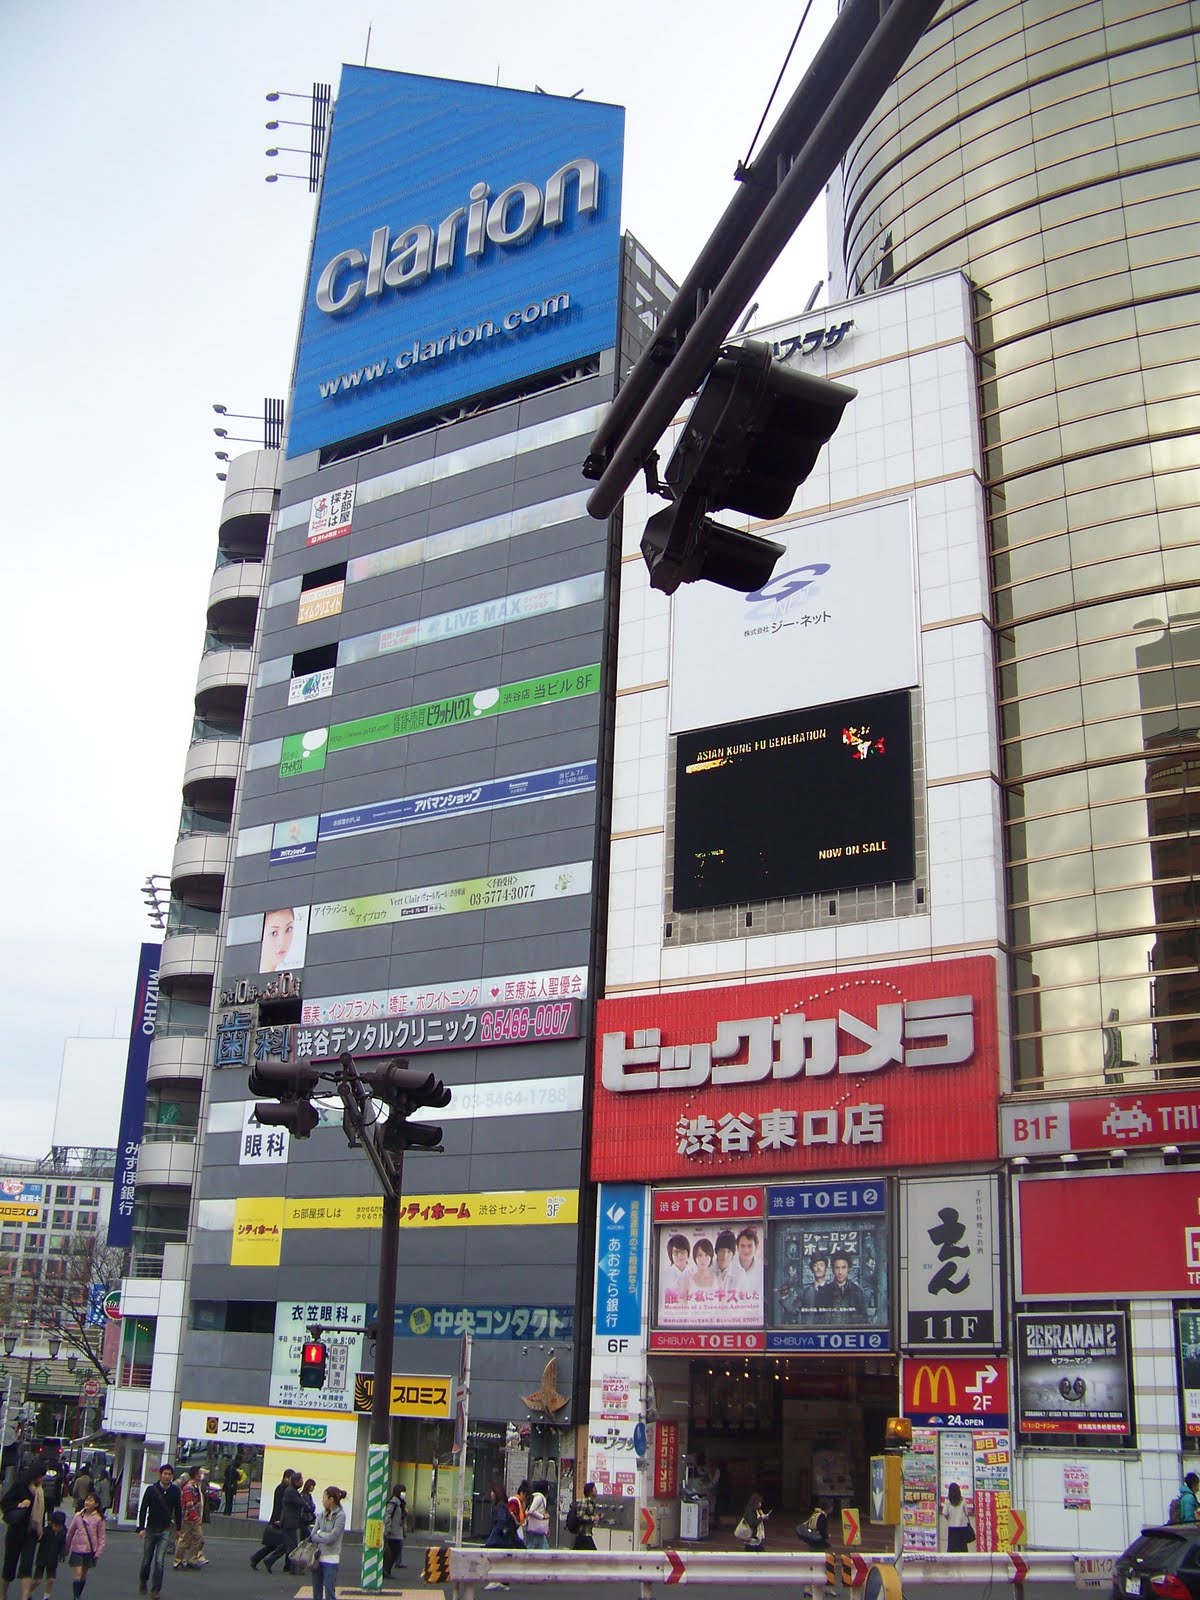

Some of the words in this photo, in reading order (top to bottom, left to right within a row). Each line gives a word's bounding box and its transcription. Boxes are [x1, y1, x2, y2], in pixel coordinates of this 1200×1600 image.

[316, 158, 600, 314] clarion
[319, 291, 571, 398] www.clarion.com
[483, 598, 521, 622] MAX
[744, 626, 769, 637] 株式会社
[771, 610, 832, 634] ジー・ネット
[426, 697, 471, 727] ピタットハウス
[503, 688, 531, 704] 渋谷店
[697, 748, 724, 762] ASIAN
[727, 742, 752, 757] KUNG
[755, 739, 767, 751] FU
[769, 728, 827, 748] GENERATION
[414, 788, 482, 813] アパマンショップ
[818, 846, 842, 860] NOW
[845, 845, 860, 856] ON
[862, 841, 888, 854] SALE
[470, 884, 536, 906] 03-5774-3077
[314, 903, 349, 917] アイラッシュ
[355, 910, 387, 923] アイブロウ
[142, 969, 160, 1035] MIZUHO
[328, 999, 380, 1020] インプラント
[415, 986, 480, 1011] ホワイトニング
[504, 974, 582, 1001] 医療法人聖優会
[214, 1010, 291, 1068] 歯科
[297, 1014, 478, 1057] 渋谷デンタルクリニック
[602, 995, 975, 1092] ビックカメラ
[676, 1103, 885, 1155] 渋谷東口店
[1013, 1115, 1058, 1142] B1F
[244, 1132, 285, 1157] 眼科
[118, 1141, 139, 1216] みずほ銀行
[478, 1204, 537, 1216] 渋谷センター
[546, 1204, 559, 1217] 3F
[659, 1200, 681, 1212] 渋谷
[684, 1196, 738, 1212] TOEI
[773, 1197, 795, 1208] 渋谷
[800, 1191, 858, 1209] TOEI
[292, 1208, 342, 1219] お部屋探しは
[238, 1224, 279, 1236] シティホーム
[803, 1231, 858, 1242] シャーロック
[605, 1238, 621, 1328] あおぞら銀行
[292, 1305, 348, 1322] 衣笠眼科
[351, 1315, 362, 1324] 4F
[434, 1308, 564, 1337] 中央コンタクト
[923, 1316, 978, 1340] 11F
[1026, 1324, 1104, 1349] ZEBRAMAN
[340, 1336, 356, 1345] 8:00
[607, 1338, 629, 1353] 6F
[657, 1335, 696, 1346] SHIBUYA
[698, 1335, 742, 1348] TOEI
[773, 1335, 815, 1347] SHIBUYA
[817, 1335, 865, 1348] TOEI
[393, 1385, 447, 1405] プロミス
[973, 1395, 993, 1411] 2F
[222, 1421, 255, 1435] プロミス
[278, 1424, 325, 1438] ポケットバンク
[976, 1439, 994, 1449] 即日
